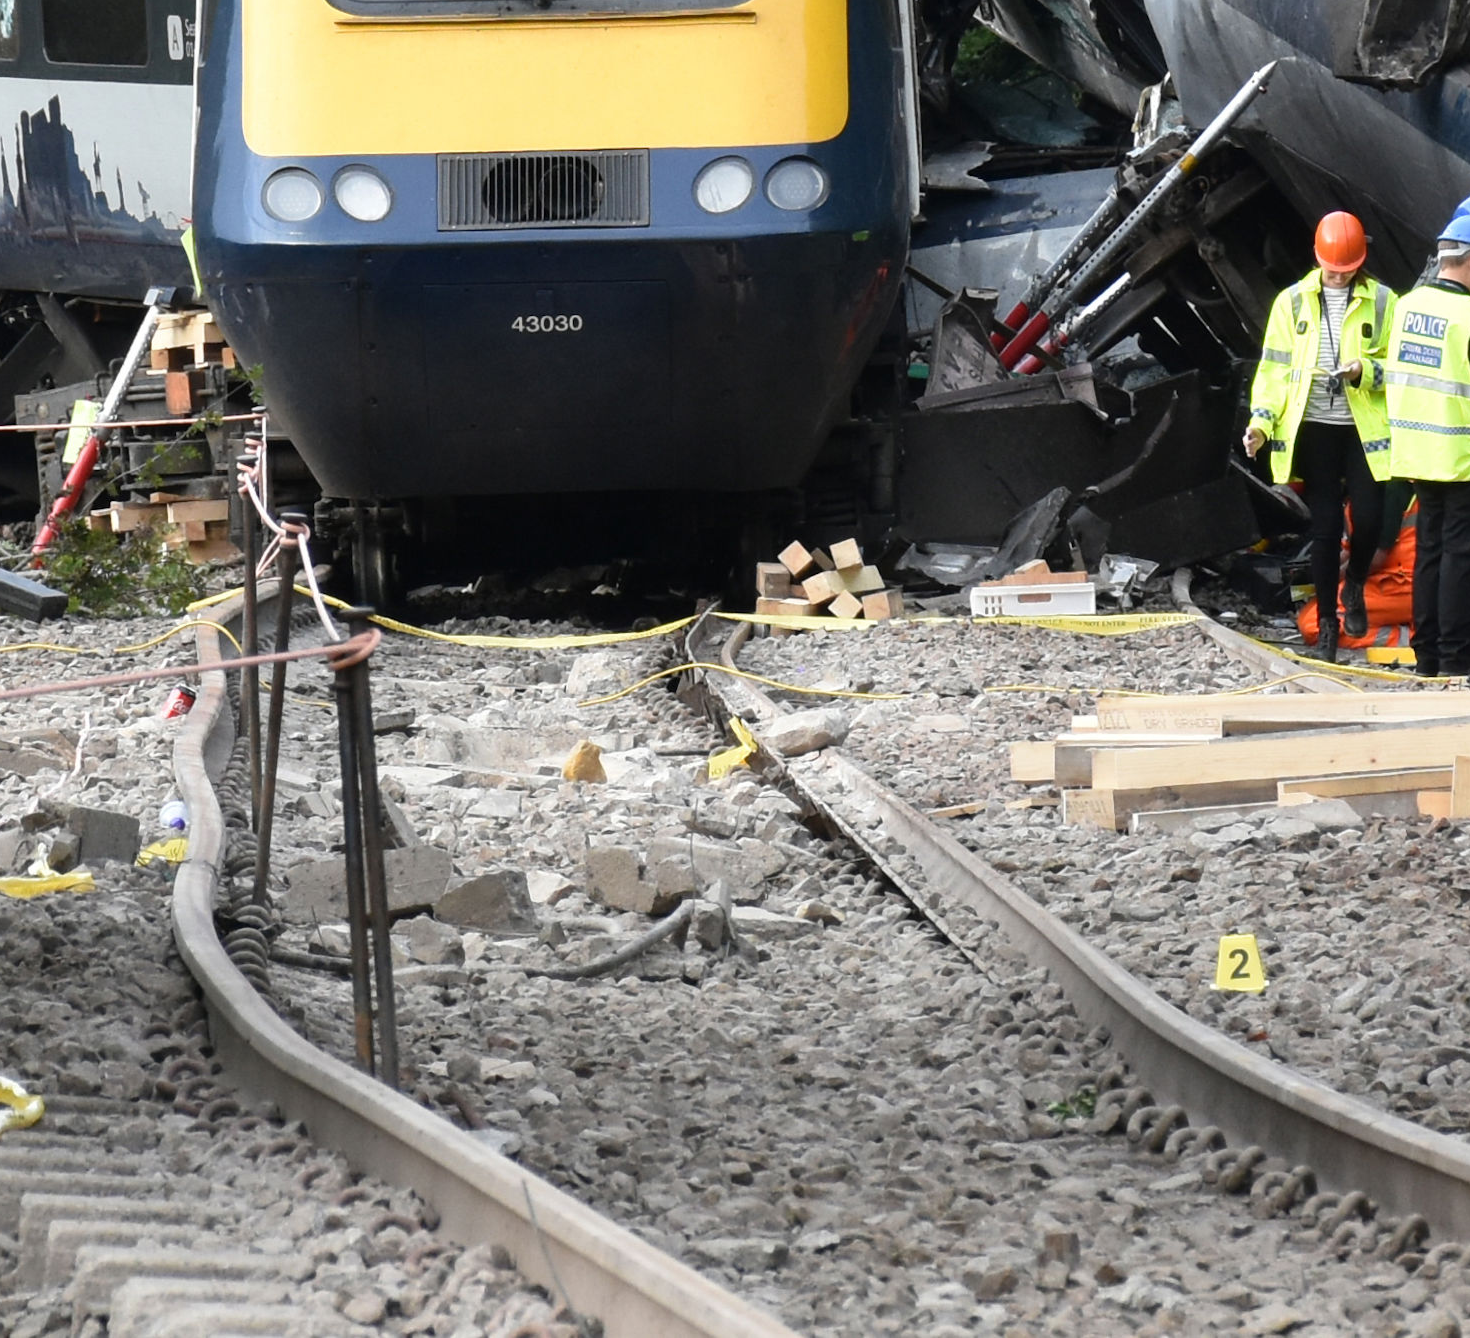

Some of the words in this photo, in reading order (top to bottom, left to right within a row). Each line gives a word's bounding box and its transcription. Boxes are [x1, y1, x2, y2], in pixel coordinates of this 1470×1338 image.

[172, 23, 180, 52] A
[511, 315, 583, 333] 43030
[1403, 312, 1447, 339] POLICE
[1229, 949, 1250, 979] 2
